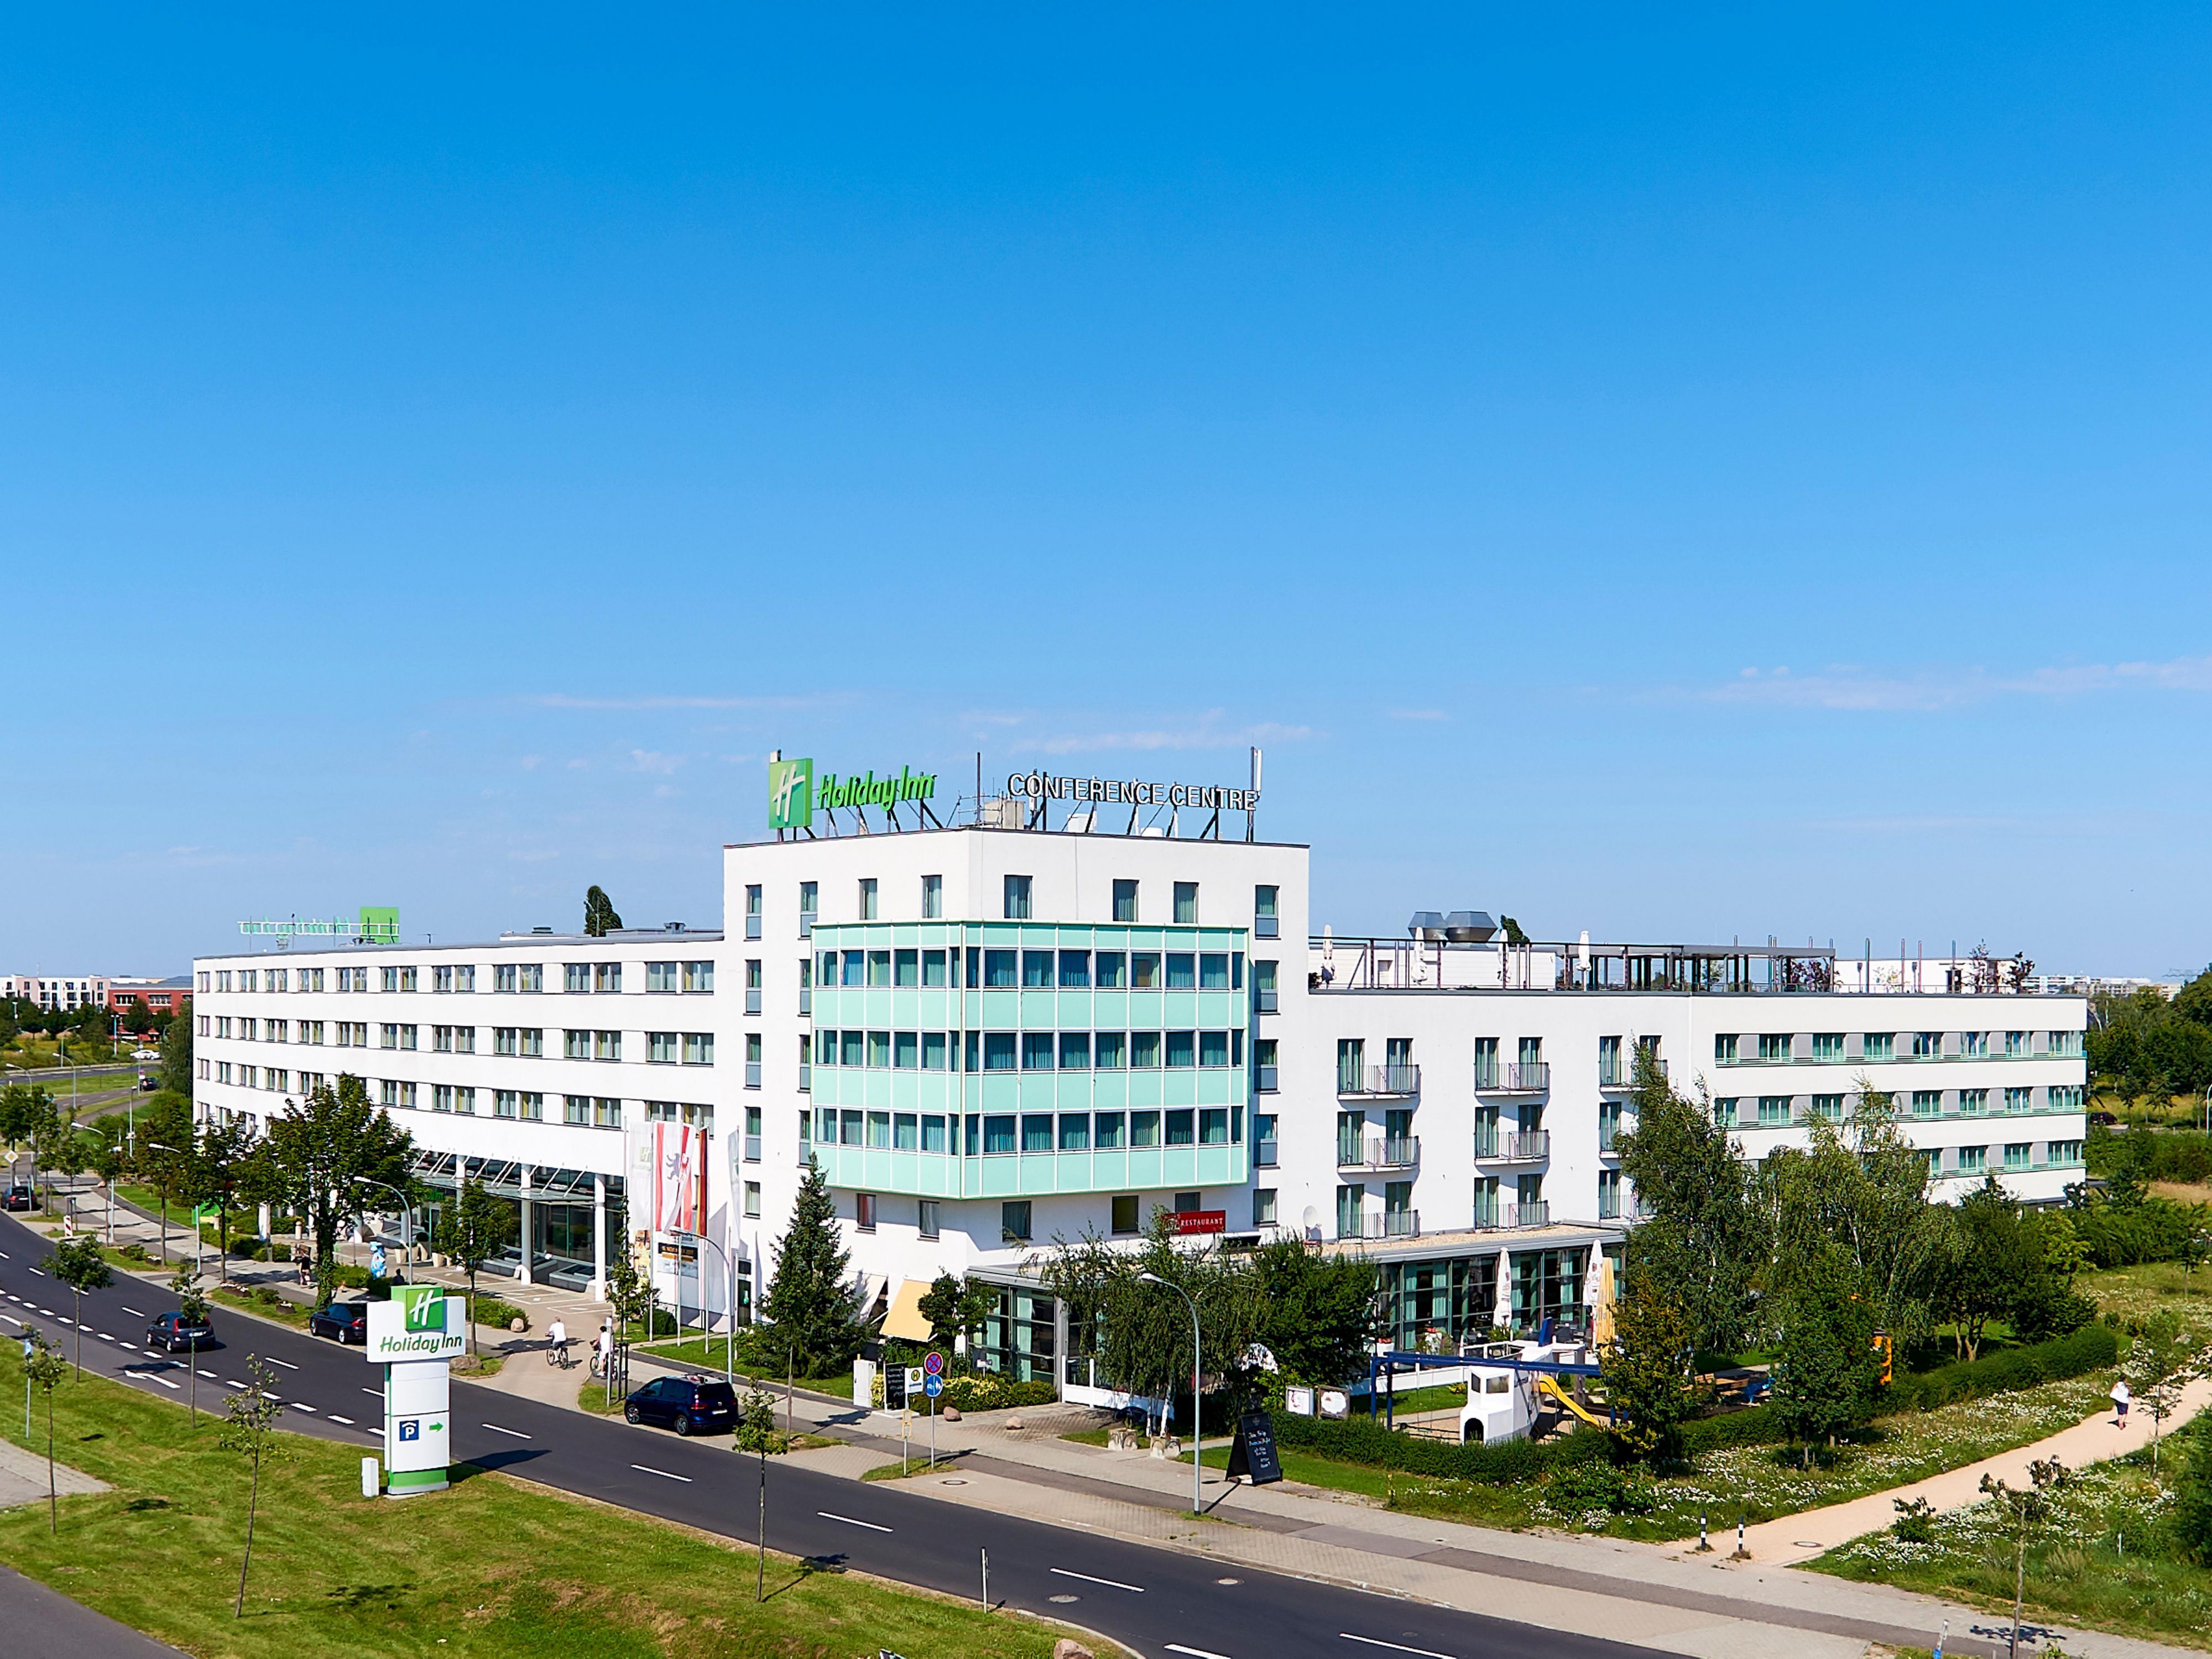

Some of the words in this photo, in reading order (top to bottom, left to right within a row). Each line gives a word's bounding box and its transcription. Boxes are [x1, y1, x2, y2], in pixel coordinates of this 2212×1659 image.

[817, 770, 899, 812] Holiday
[901, 765, 937, 801] Inn
[1008, 773, 1164, 804] CONFERENCE
[1169, 784, 1256, 811] CENTRE
[1181, 1218, 1223, 1227] RESTAURANT
[379, 1335, 440, 1353] Holiday
[441, 1333, 462, 1349] Inn
[405, 1426, 415, 1439] P
